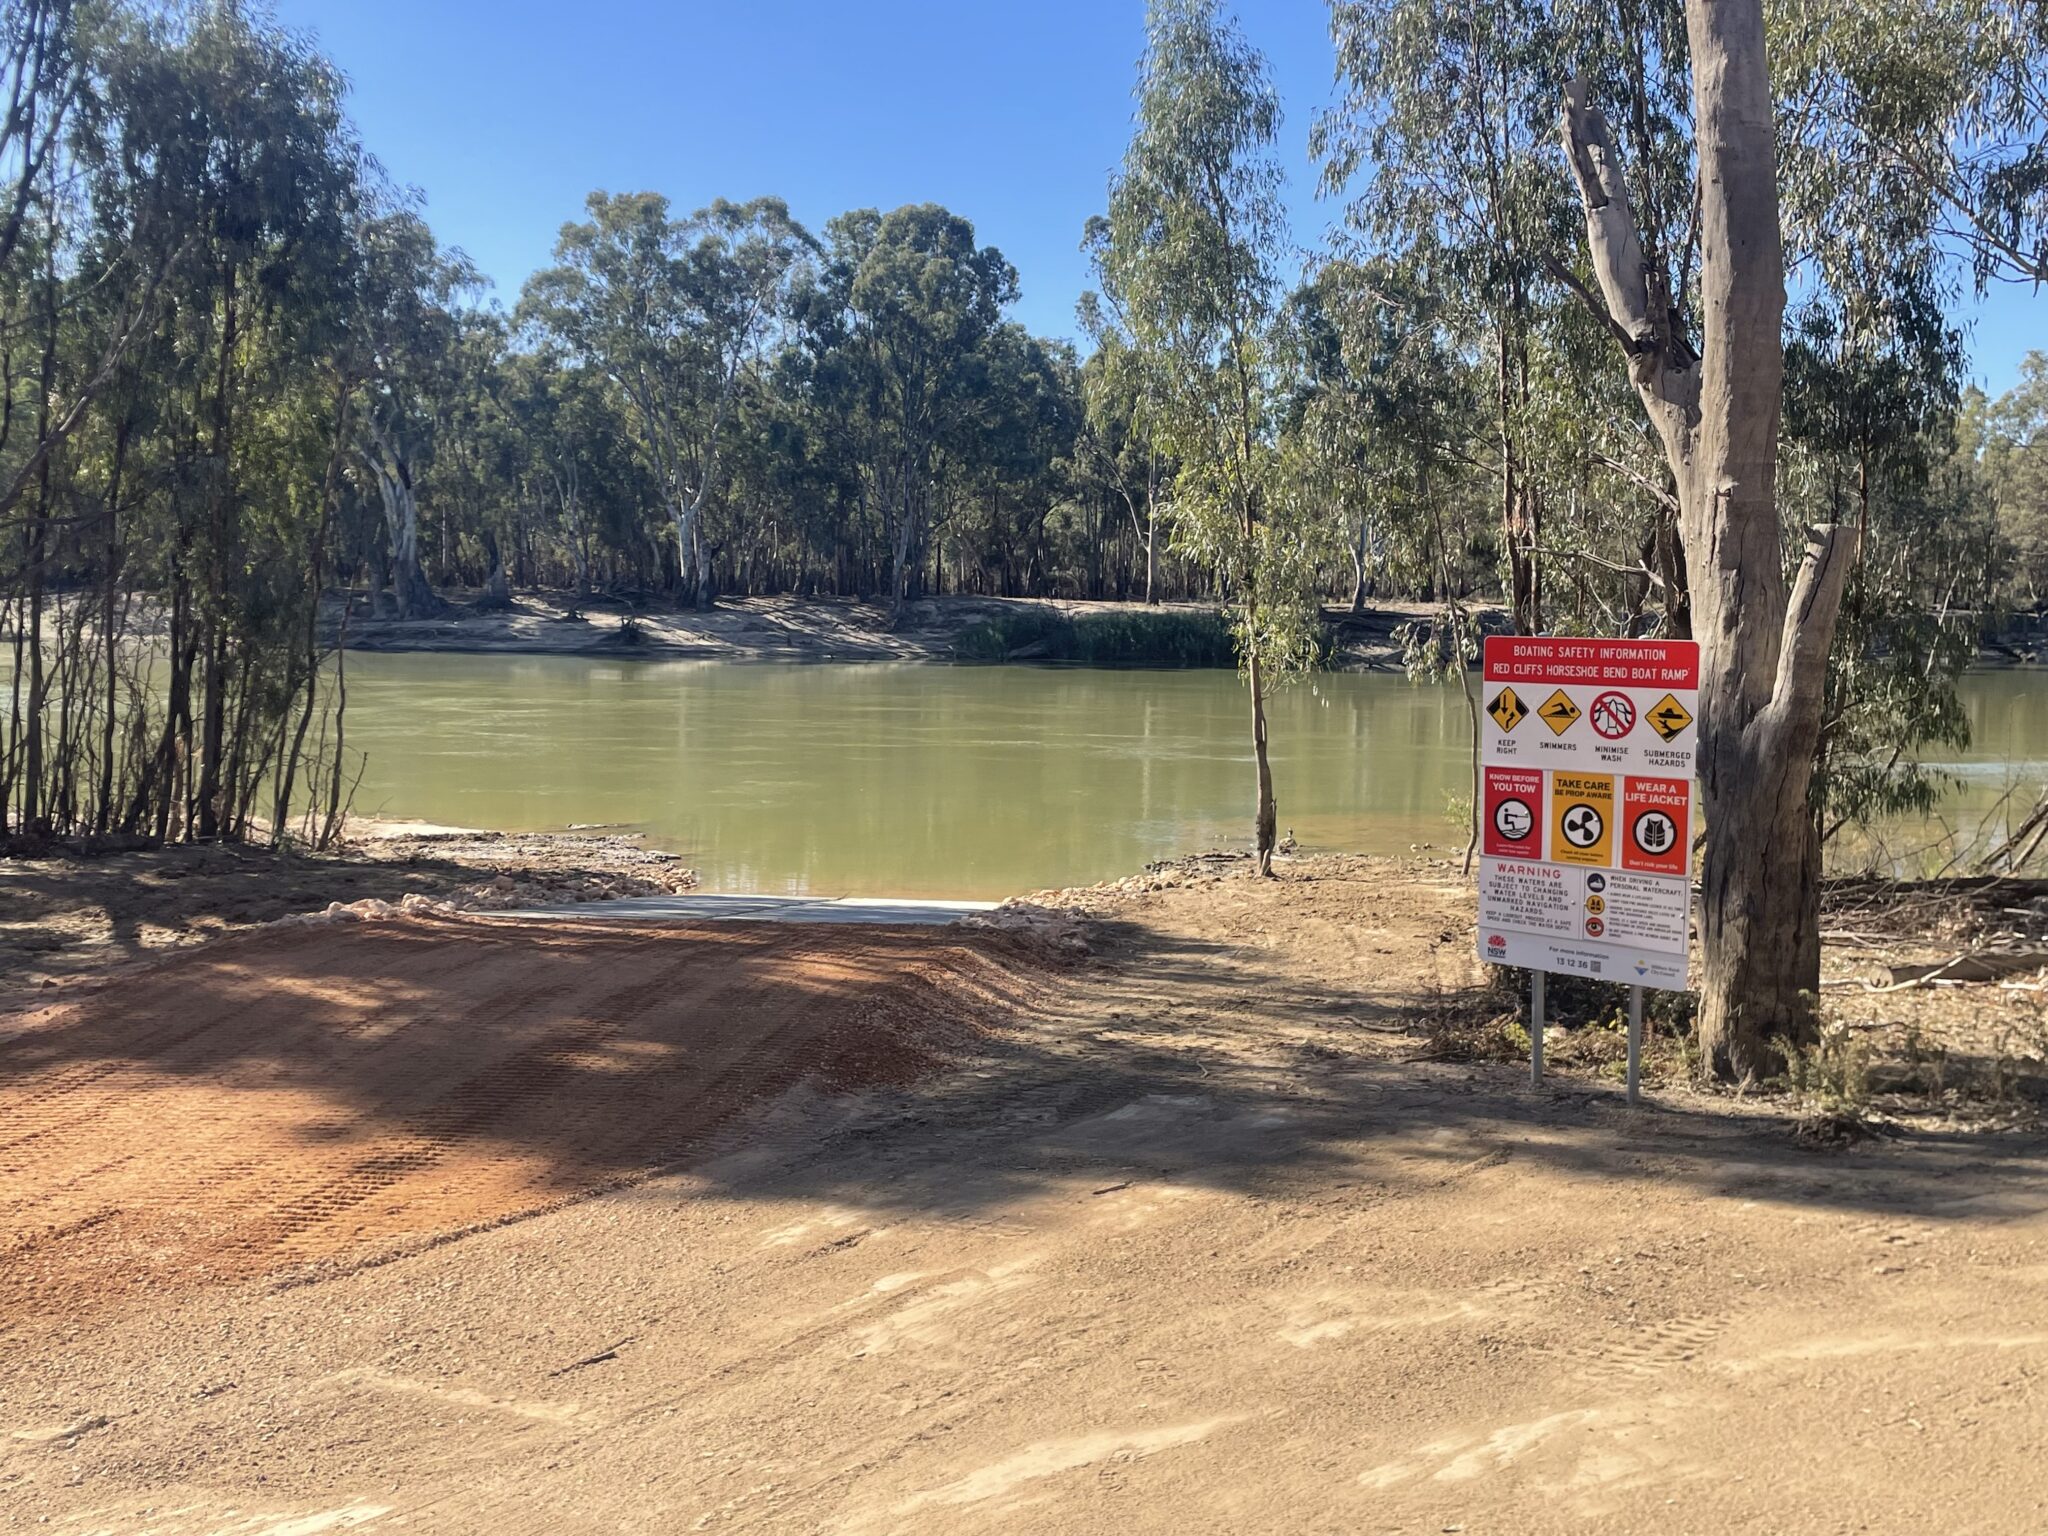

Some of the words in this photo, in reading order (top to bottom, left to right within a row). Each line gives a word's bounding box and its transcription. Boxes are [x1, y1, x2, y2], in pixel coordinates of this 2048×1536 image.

[1513, 645, 1553, 658] BOATING
[1558, 646, 1594, 658] SAFETY
[1600, 648, 1666, 661] INFORMATION
[1493, 662, 1510, 674] RED
[1514, 664, 1542, 676] CLIFFS
[1547, 665, 1599, 678] HORSESHOE
[1603, 667, 1628, 679] BEND
[1632, 668, 1656, 680] BOAT
[1661, 669, 1688, 681] RAMP
[1540, 742, 1577, 751] SWIMMERS
[1595, 746, 1629, 755] MINIMISE
[1601, 754, 1622, 762] WASH
[1644, 750, 1691, 760] SUBMERGED
[1648, 758, 1686, 768] HAZARDS
[1489, 773, 1510, 781] KNOW
[1512, 775, 1540, 783] BEFORE
[1493, 782, 1512, 792] YOU
[1514, 784, 1536, 793] TOW
[1557, 779, 1582, 789] TAKE
[1584, 780, 1610, 791] CARE
[1636, 782, 1666, 793] WEAR
[1668, 784, 1676, 793] A
[1564, 790, 1585, 798] PROP
[1586, 792, 1612, 800] AWARE
[1625, 793, 1646, 803] LIFE
[1648, 794, 1688, 806] JACKET
[1497, 863, 1561, 879] WARNING
[1519, 878, 1545, 886] WATERS
[1610, 882, 1640, 892] PERSONAL
[1488, 881, 1518, 890] SUBJECT
[1533, 886, 1568, 896] CHANGING
[1519, 892, 1544, 900] LEVELS
[1488, 895, 1523, 905] UNMARKED
[1527, 900, 1569, 911] NAVIGATION
[1510, 905, 1544, 915] HAZARDS.
[1488, 947, 1506, 955] NSW
[1576, 950, 1609, 959] information
[1568, 959, 1575, 967] 12
[1577, 960, 1588, 968] 36
